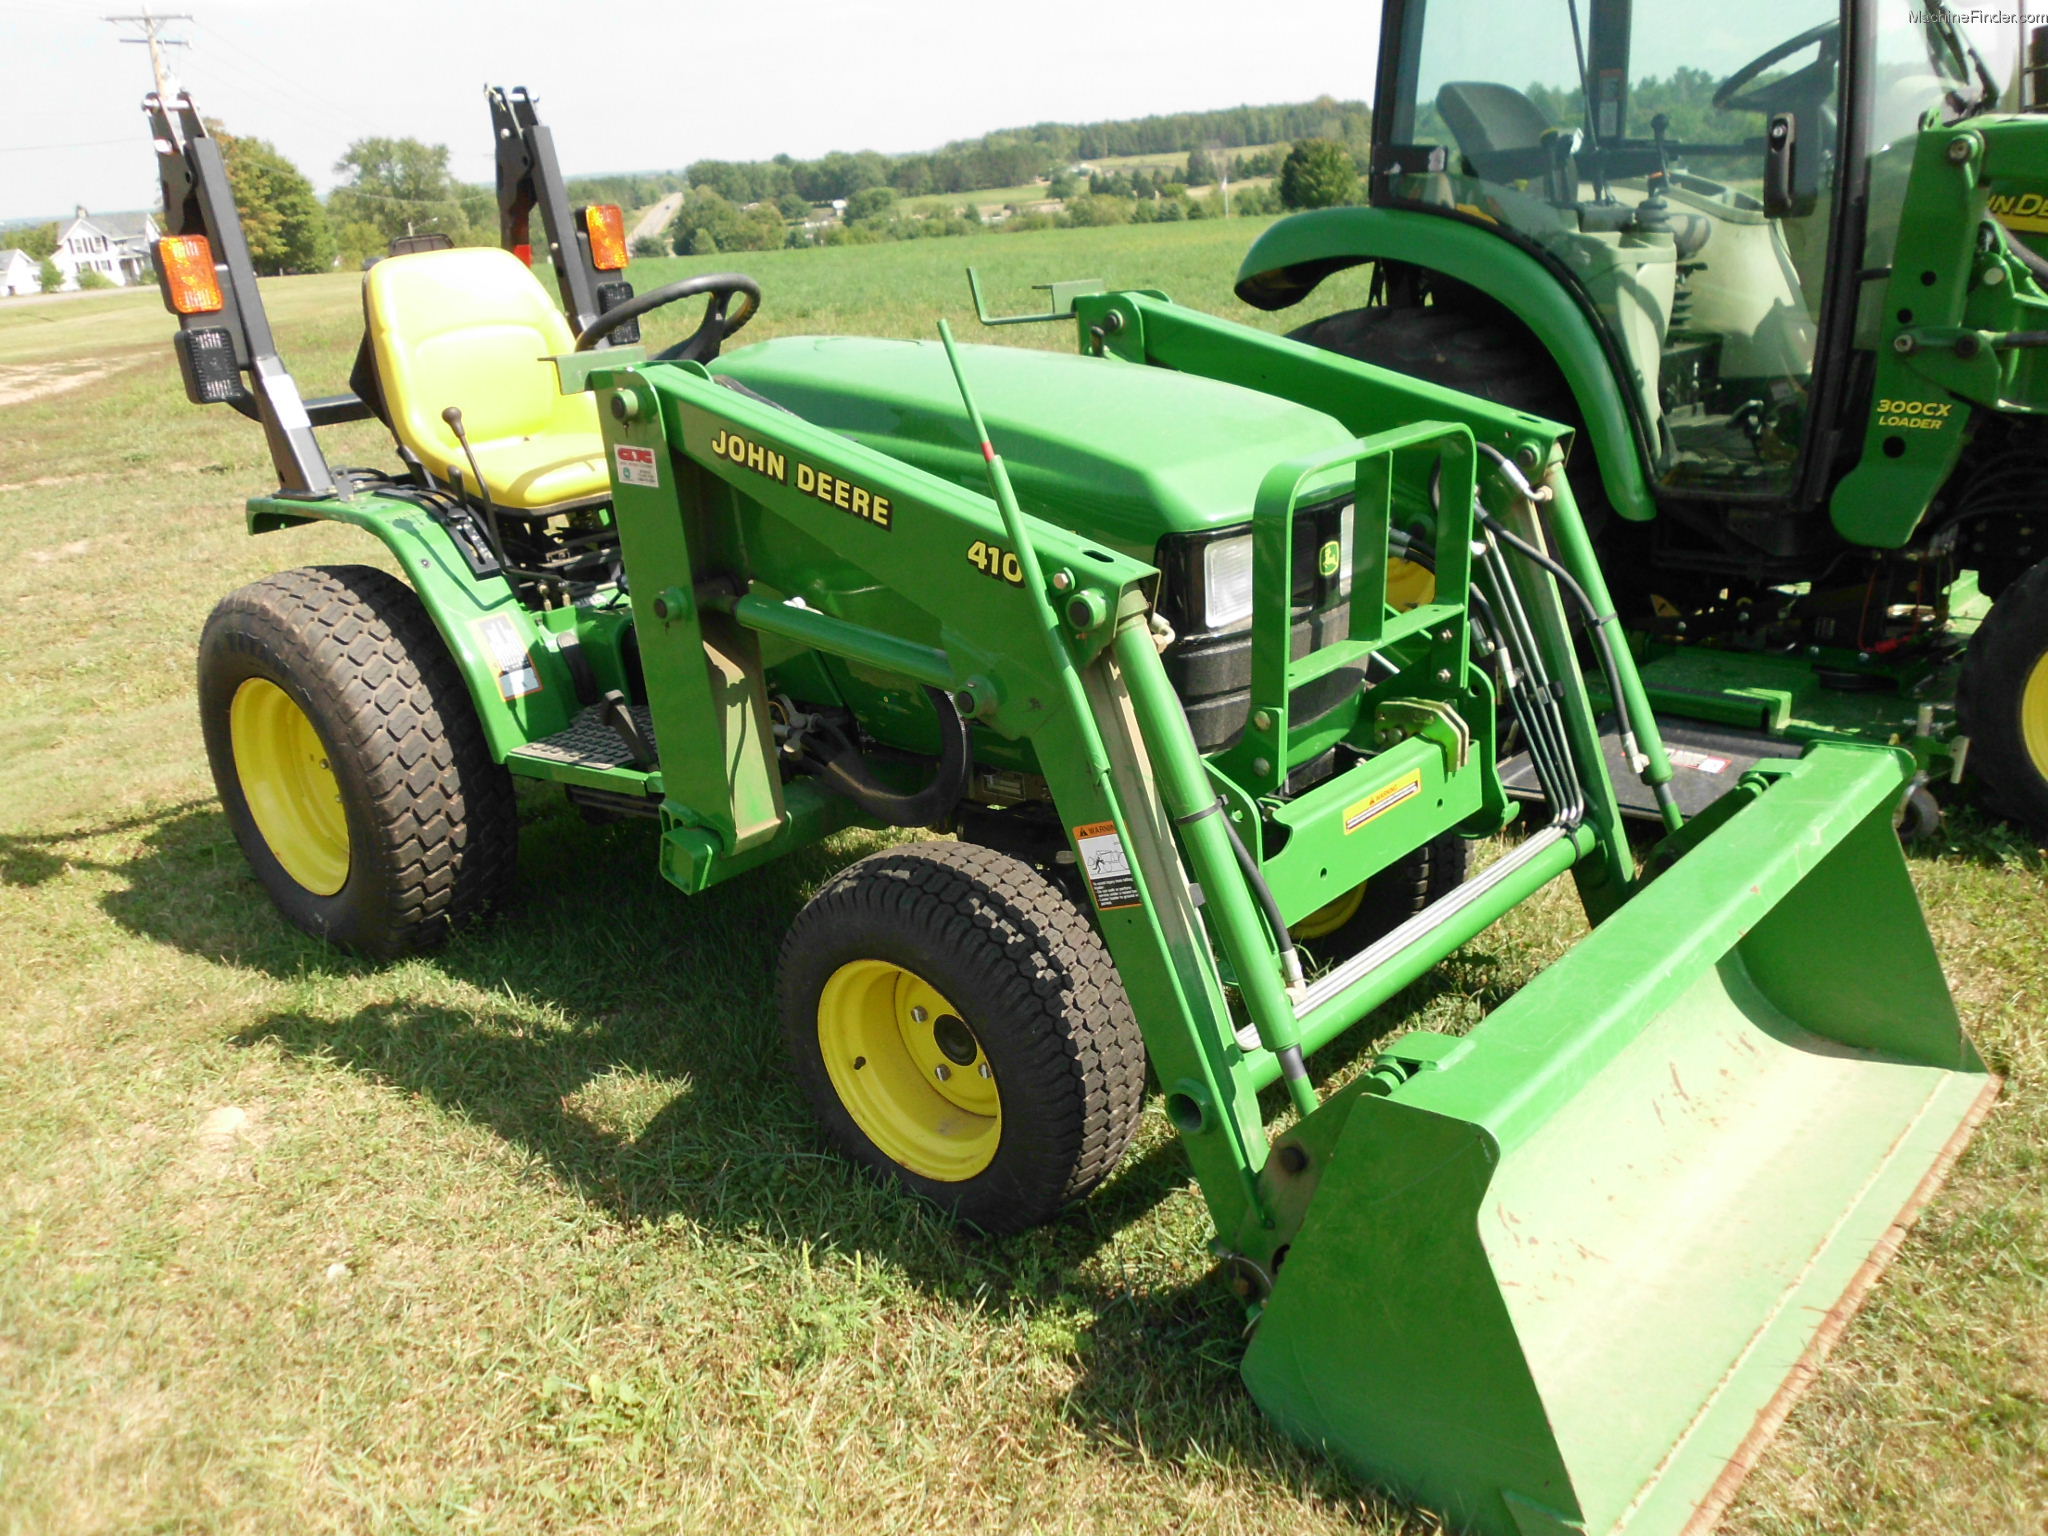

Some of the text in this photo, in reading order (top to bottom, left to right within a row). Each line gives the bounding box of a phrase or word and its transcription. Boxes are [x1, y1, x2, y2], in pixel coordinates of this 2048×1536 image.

[1876, 399, 1952, 417] 300CX
[1878, 416, 1942, 430] LOADER
[711, 429, 890, 527] JOHN DEERE
[967, 540, 1023, 584] 410
[1089, 824, 1116, 834] WARNIN
